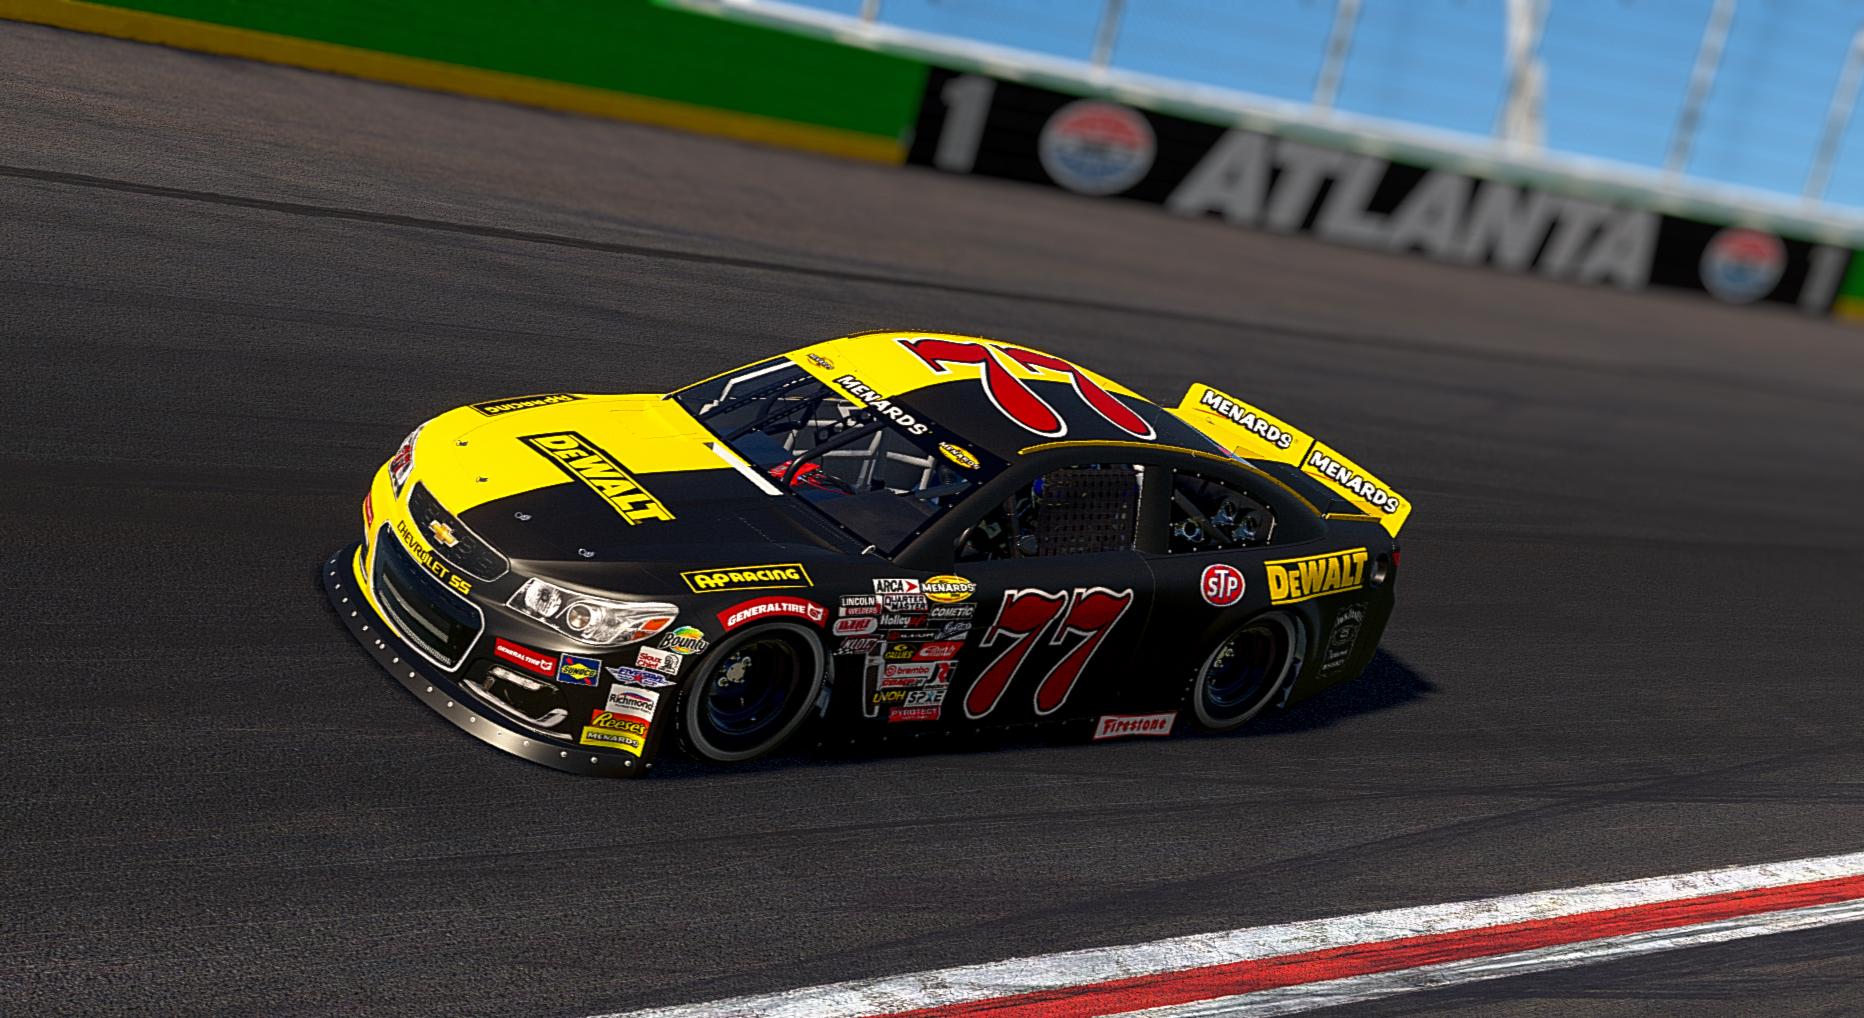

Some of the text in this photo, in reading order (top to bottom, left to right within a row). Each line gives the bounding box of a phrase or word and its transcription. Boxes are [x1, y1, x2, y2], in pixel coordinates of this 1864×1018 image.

[934, 74, 996, 172] 1
[1167, 130, 1661, 289] ATLANTA
[892, 338, 1158, 440] 77
[832, 374, 928, 435] MENARDS
[1200, 389, 1293, 449] MENARDS
[1309, 451, 1400, 514] MENARDS
[397, 520, 473, 595] CHEVROLET SS
[877, 580, 904, 593] ARCA
[921, 582, 975, 593] MENARDS
[1207, 569, 1238, 599] STP
[841, 597, 876, 606] LINCOLN
[880, 614, 911, 628] Holley
[657, 632, 709, 654] Bounty
[963, 586, 1134, 719] 77
[562, 665, 596, 677] SUNOCO
[609, 694, 654, 710] Richmond
[592, 712, 646, 735] Reese's
[1103, 719, 1167, 735] Firestone
[586, 731, 640, 747] MENARDS
